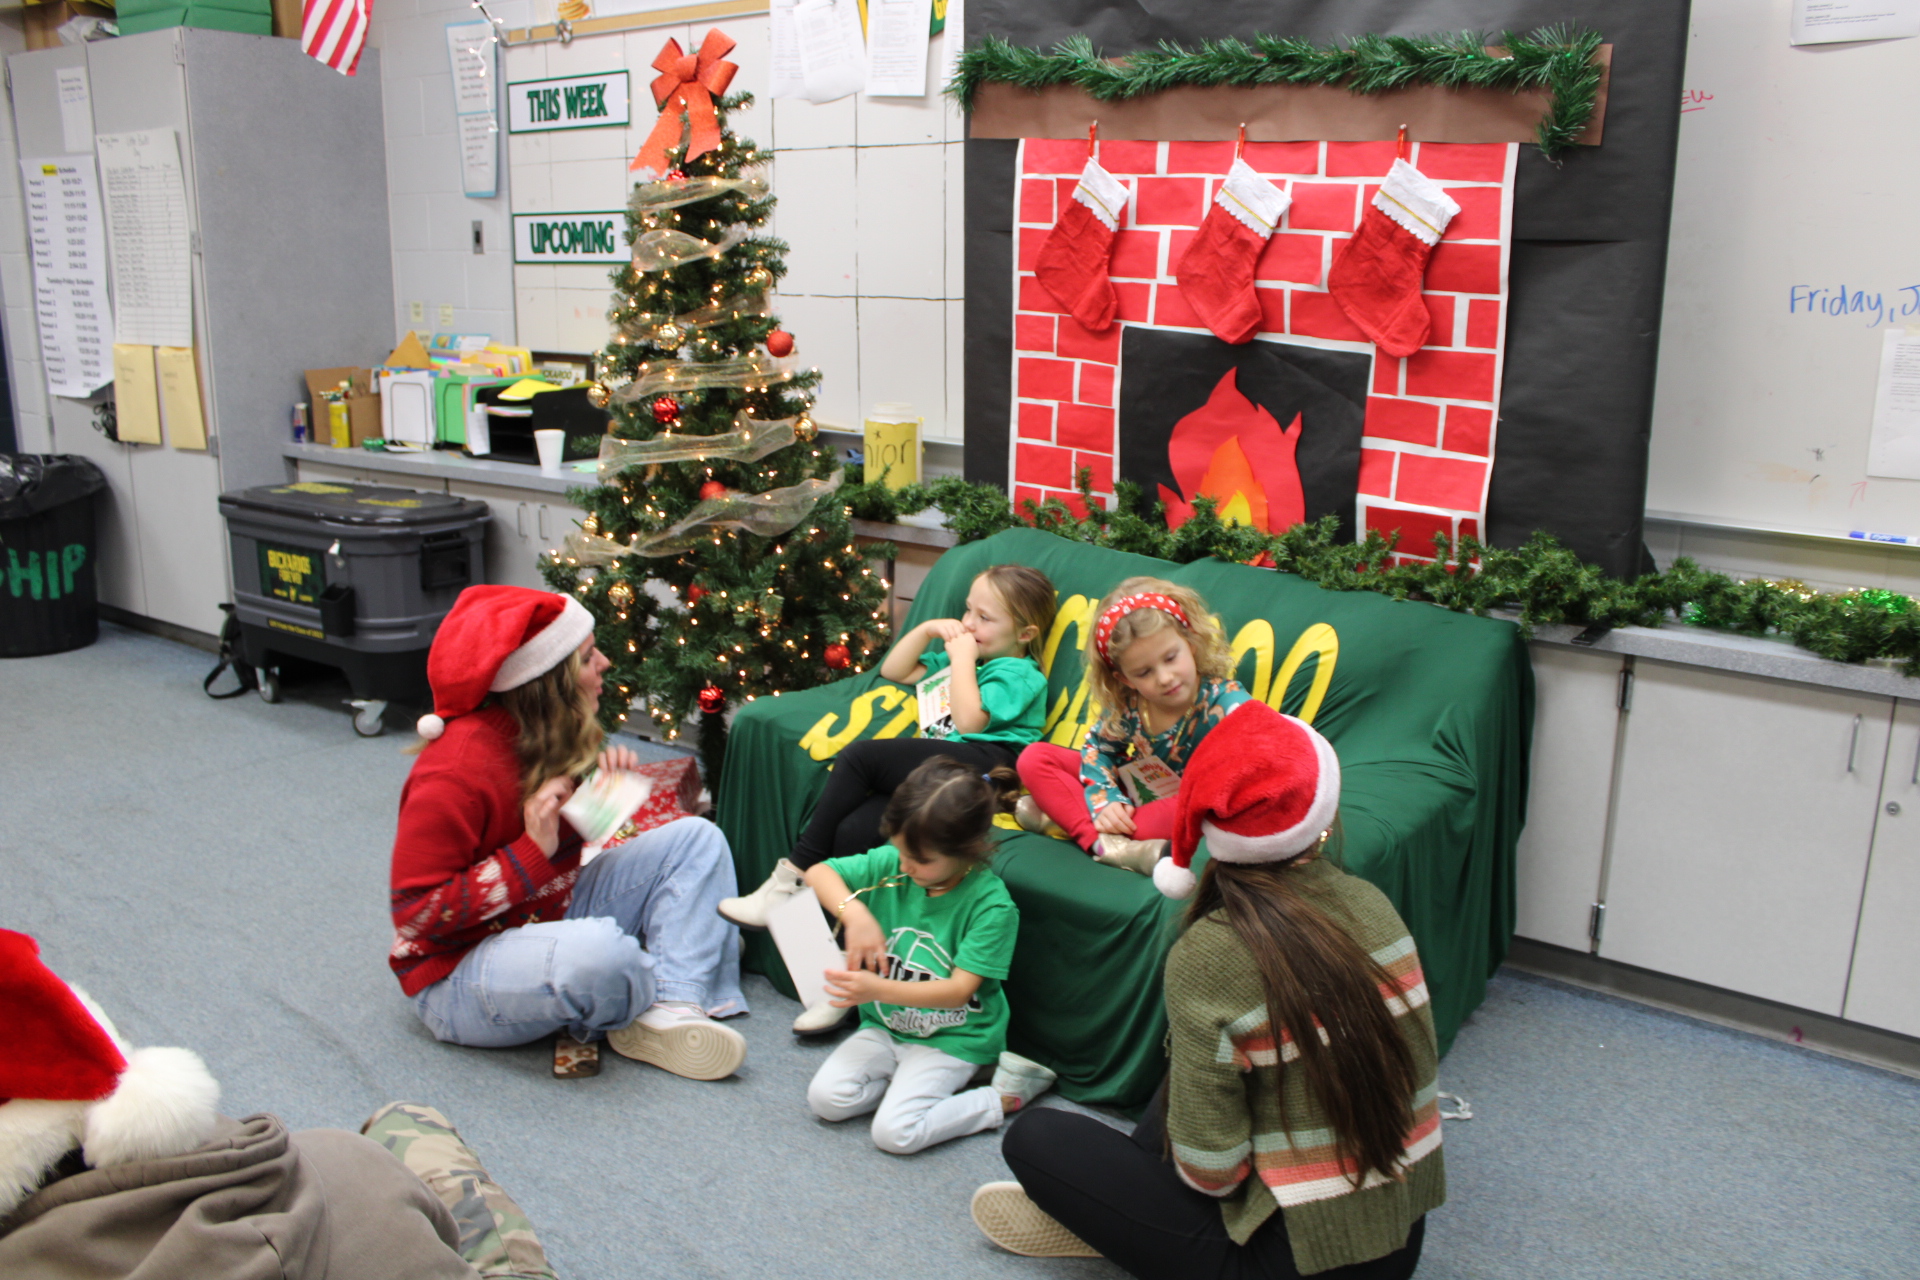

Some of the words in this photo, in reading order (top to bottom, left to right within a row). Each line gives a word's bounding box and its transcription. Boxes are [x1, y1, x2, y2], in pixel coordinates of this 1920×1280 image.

[527, 87, 561, 123] THIS
[563, 83, 608, 119] WEEK
[530, 221, 614, 254] UPCOMING
